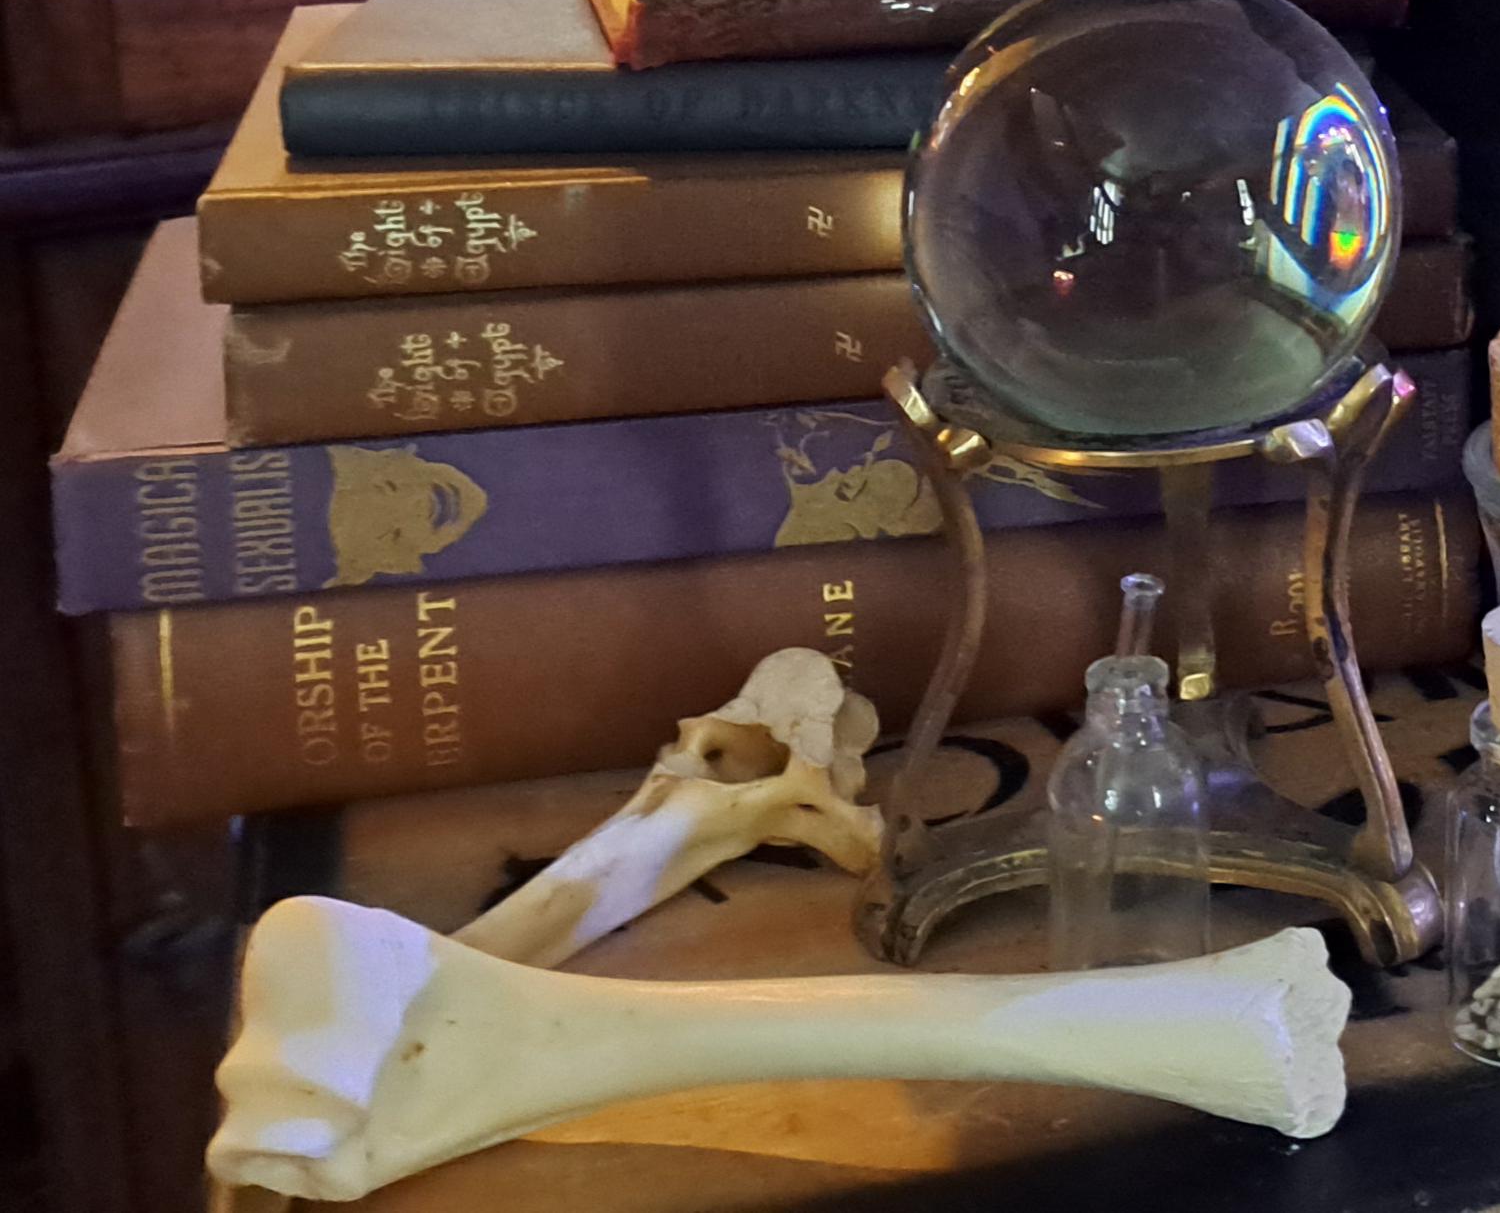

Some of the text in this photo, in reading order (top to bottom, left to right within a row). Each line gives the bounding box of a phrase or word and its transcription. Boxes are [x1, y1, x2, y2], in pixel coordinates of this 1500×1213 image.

[134, 458, 205, 603] MAGICA
[229, 451, 298, 595] SEXUALIS
[292, 605, 338, 766] ORSHIP
[355, 638, 394, 764] OF THE
